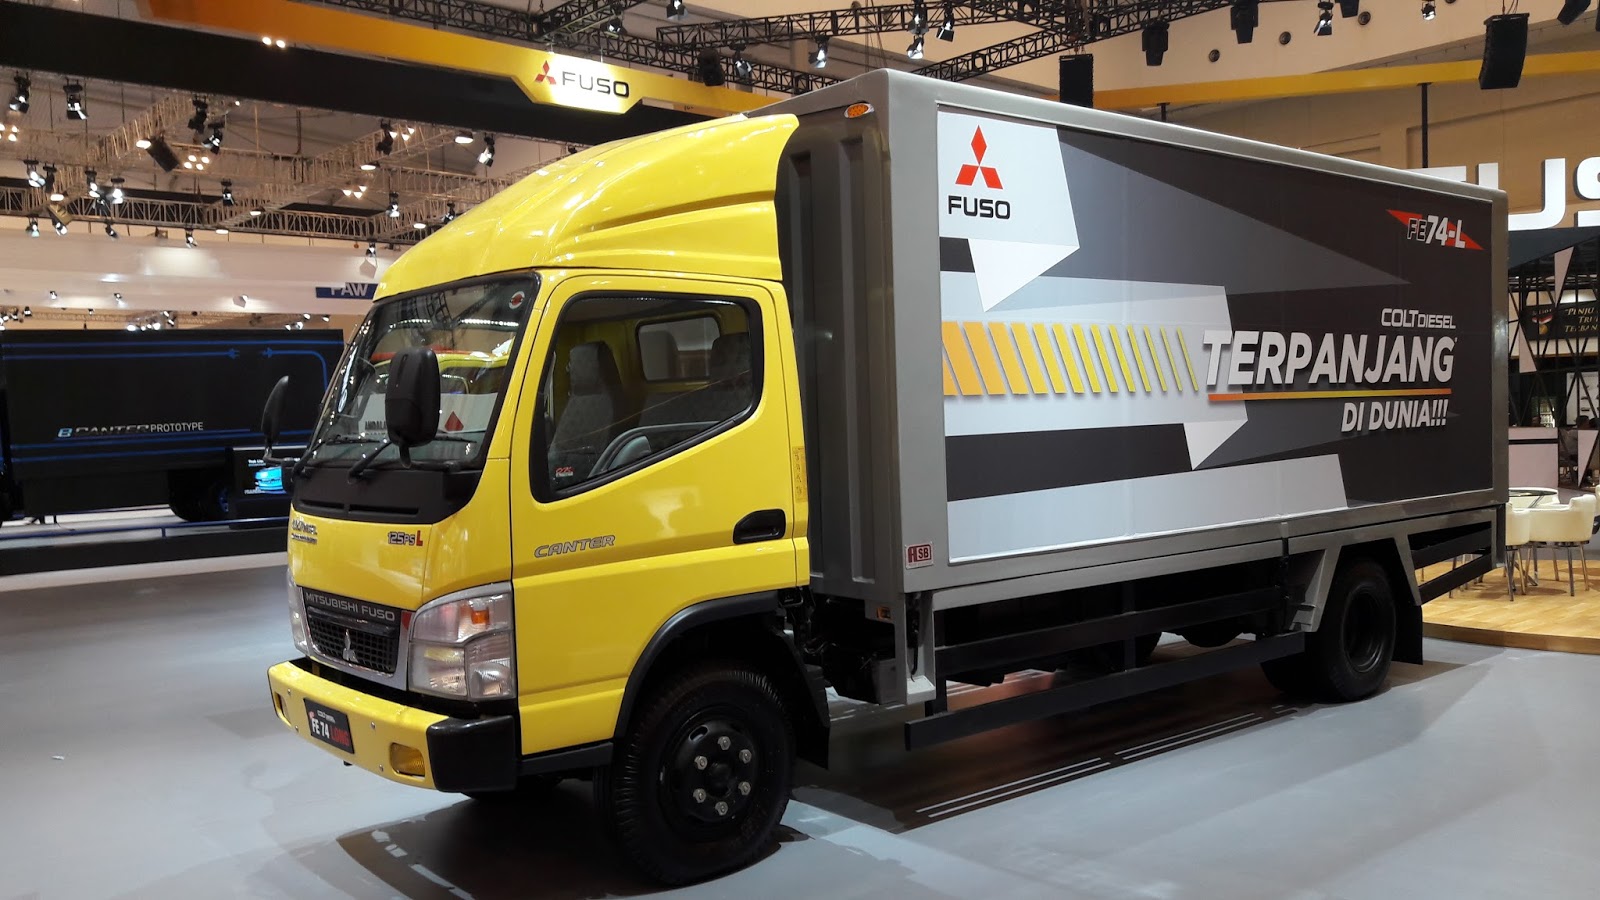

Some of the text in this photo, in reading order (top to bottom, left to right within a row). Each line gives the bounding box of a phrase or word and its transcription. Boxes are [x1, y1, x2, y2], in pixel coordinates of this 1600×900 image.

[562, 71, 630, 99] FUSO
[948, 195, 1011, 220] FUSO
[150, 421, 204, 432] PROTOTYPE
[1341, 399, 1450, 432] DI DUNIA!!!
[534, 534, 616, 559] CANTER
[305, 592, 396, 622] MITSUBISHI FUSO
[311, 717, 321, 735] FE
[320, 720, 330, 739] 74
